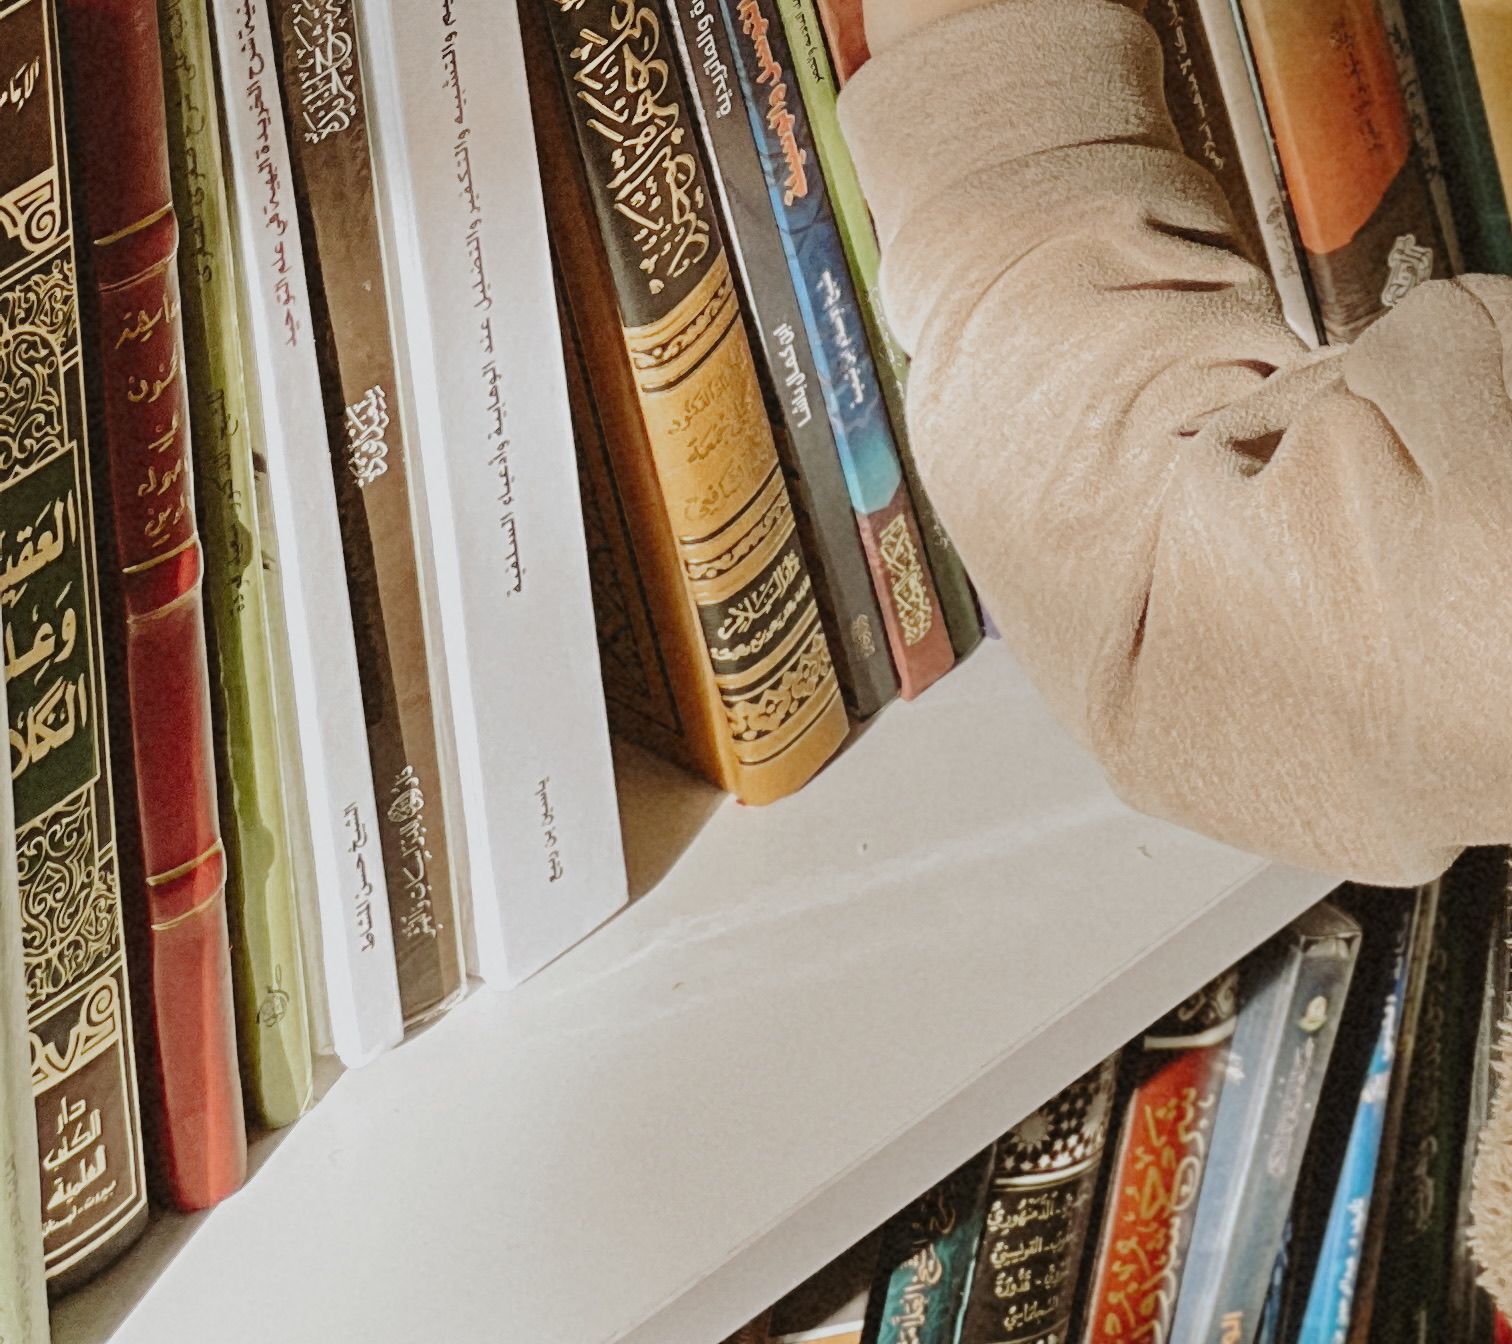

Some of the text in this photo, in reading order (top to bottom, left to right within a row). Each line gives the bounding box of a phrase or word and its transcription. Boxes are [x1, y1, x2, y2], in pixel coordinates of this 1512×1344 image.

[237, 31, 266, 79] شرح
[440, 30, 465, 125] والتشبيه
[689, 13, 734, 119] والماتريدية
[245, 79, 273, 155] الخريدة
[257, 157, 280, 208] البهية
[452, 127, 481, 213] والتكفير
[263, 206, 288, 236] في
[273, 240, 289, 273] علم
[464, 217, 494, 310] والتضليل
[274, 276, 298, 347] التوحيد
[479, 316, 495, 354] عند
[481, 360, 504, 441] الوهابية
[772, 322, 813, 427] ابن كمال باشا
[487, 440, 515, 505] وأدعياء
[499, 511, 523, 597] السلفية
[534, 776, 565, 883] ياسين بن ربيع
[343, 801, 376, 952] الشيخ حسن المشاط
[43, 1108, 102, 1172] الكتب
[57, 1095, 87, 1135] دار
[46, 1144, 107, 1210] العلمية
